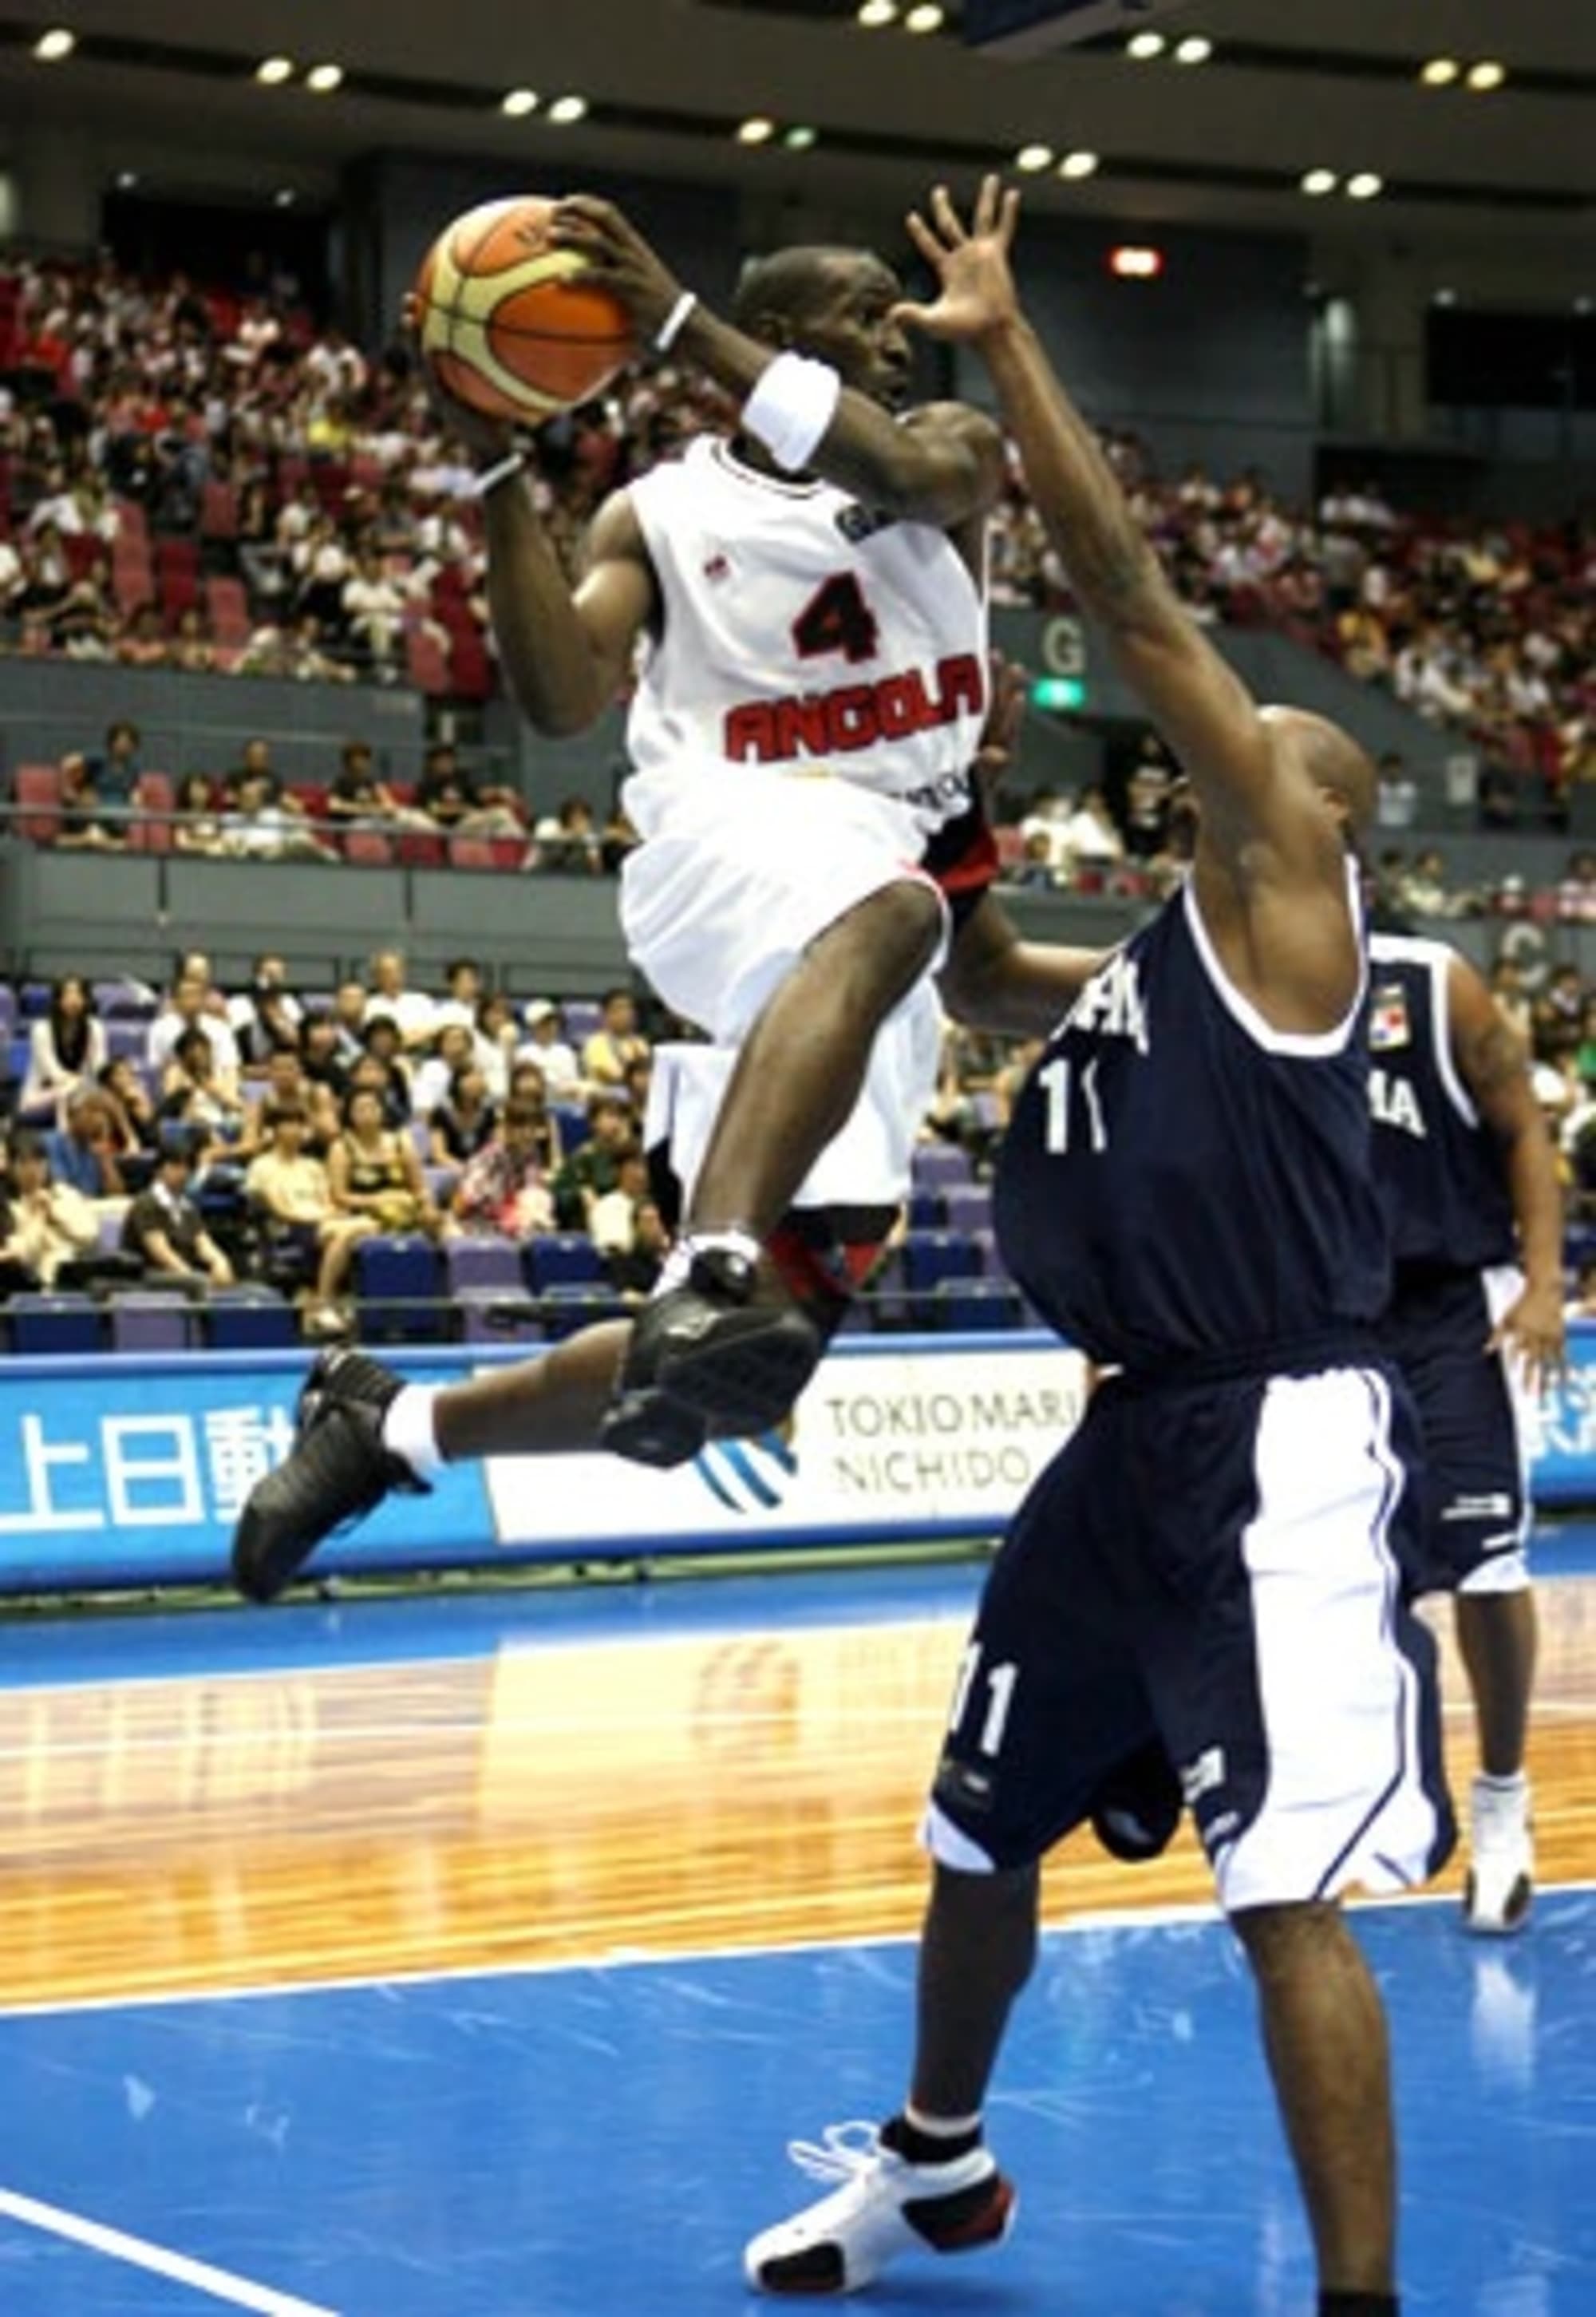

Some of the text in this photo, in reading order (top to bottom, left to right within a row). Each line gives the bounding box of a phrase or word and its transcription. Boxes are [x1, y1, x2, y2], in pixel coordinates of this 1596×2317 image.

[792, 567, 879, 663] 4
[1042, 616, 1087, 675] G
[723, 653, 986, 763] ANGOLA
[1039, 1058, 1107, 1153] 11
[825, 1394, 962, 1437] TOKIO
[835, 1446, 1032, 1495] NICHIDO
